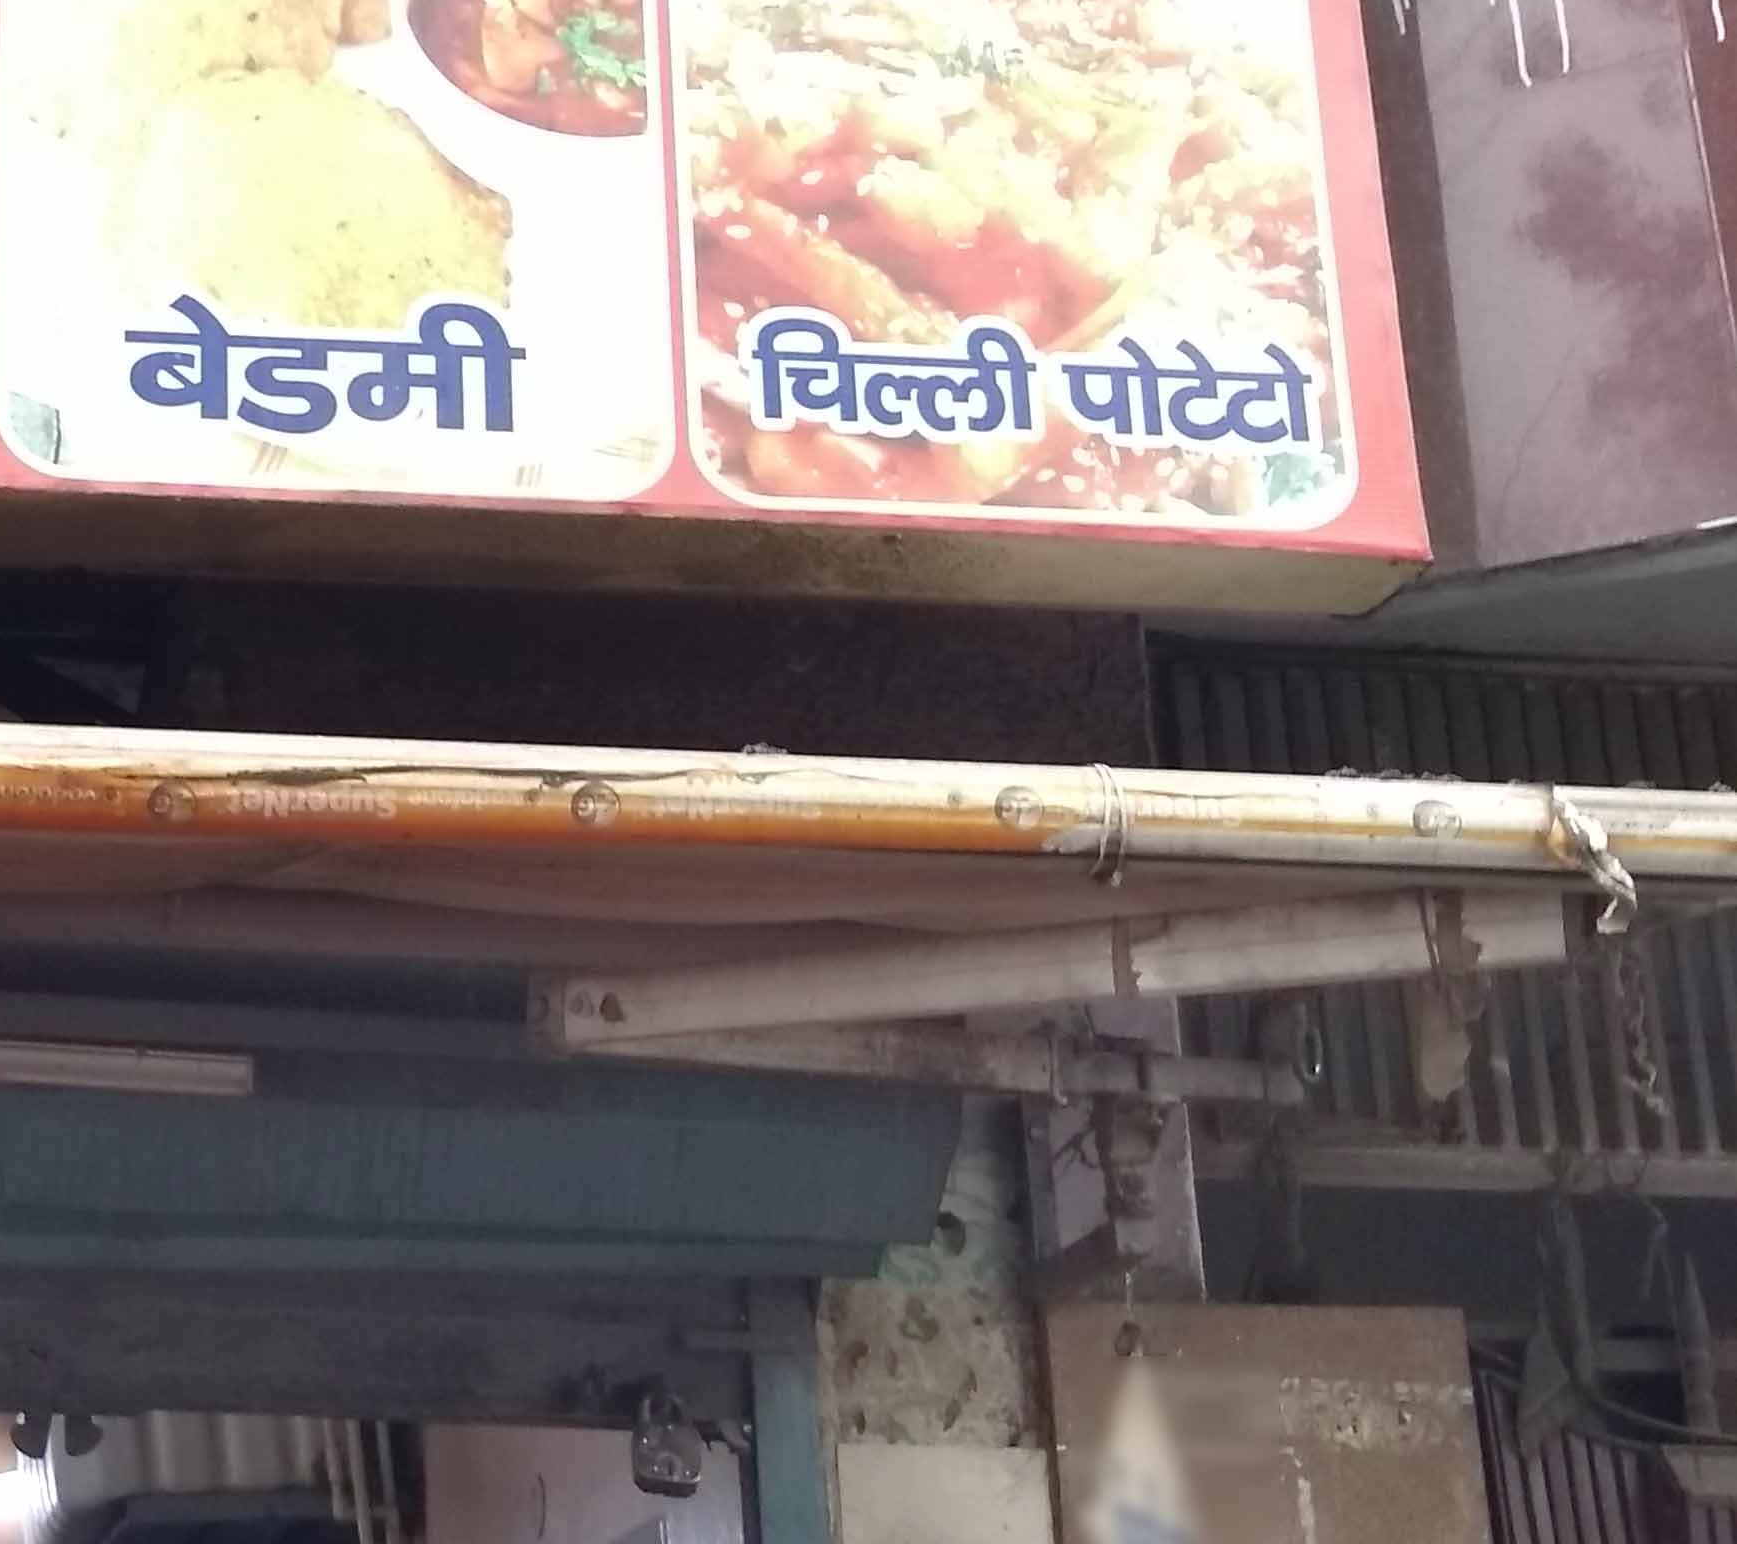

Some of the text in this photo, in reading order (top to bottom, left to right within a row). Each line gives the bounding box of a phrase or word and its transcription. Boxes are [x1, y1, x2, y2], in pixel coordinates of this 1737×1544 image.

[127, 296, 524, 433] बेडमी
[754, 319, 1310, 441] चिल्ली पोटेटो
[224, 784, 398, 820] SuperNet
